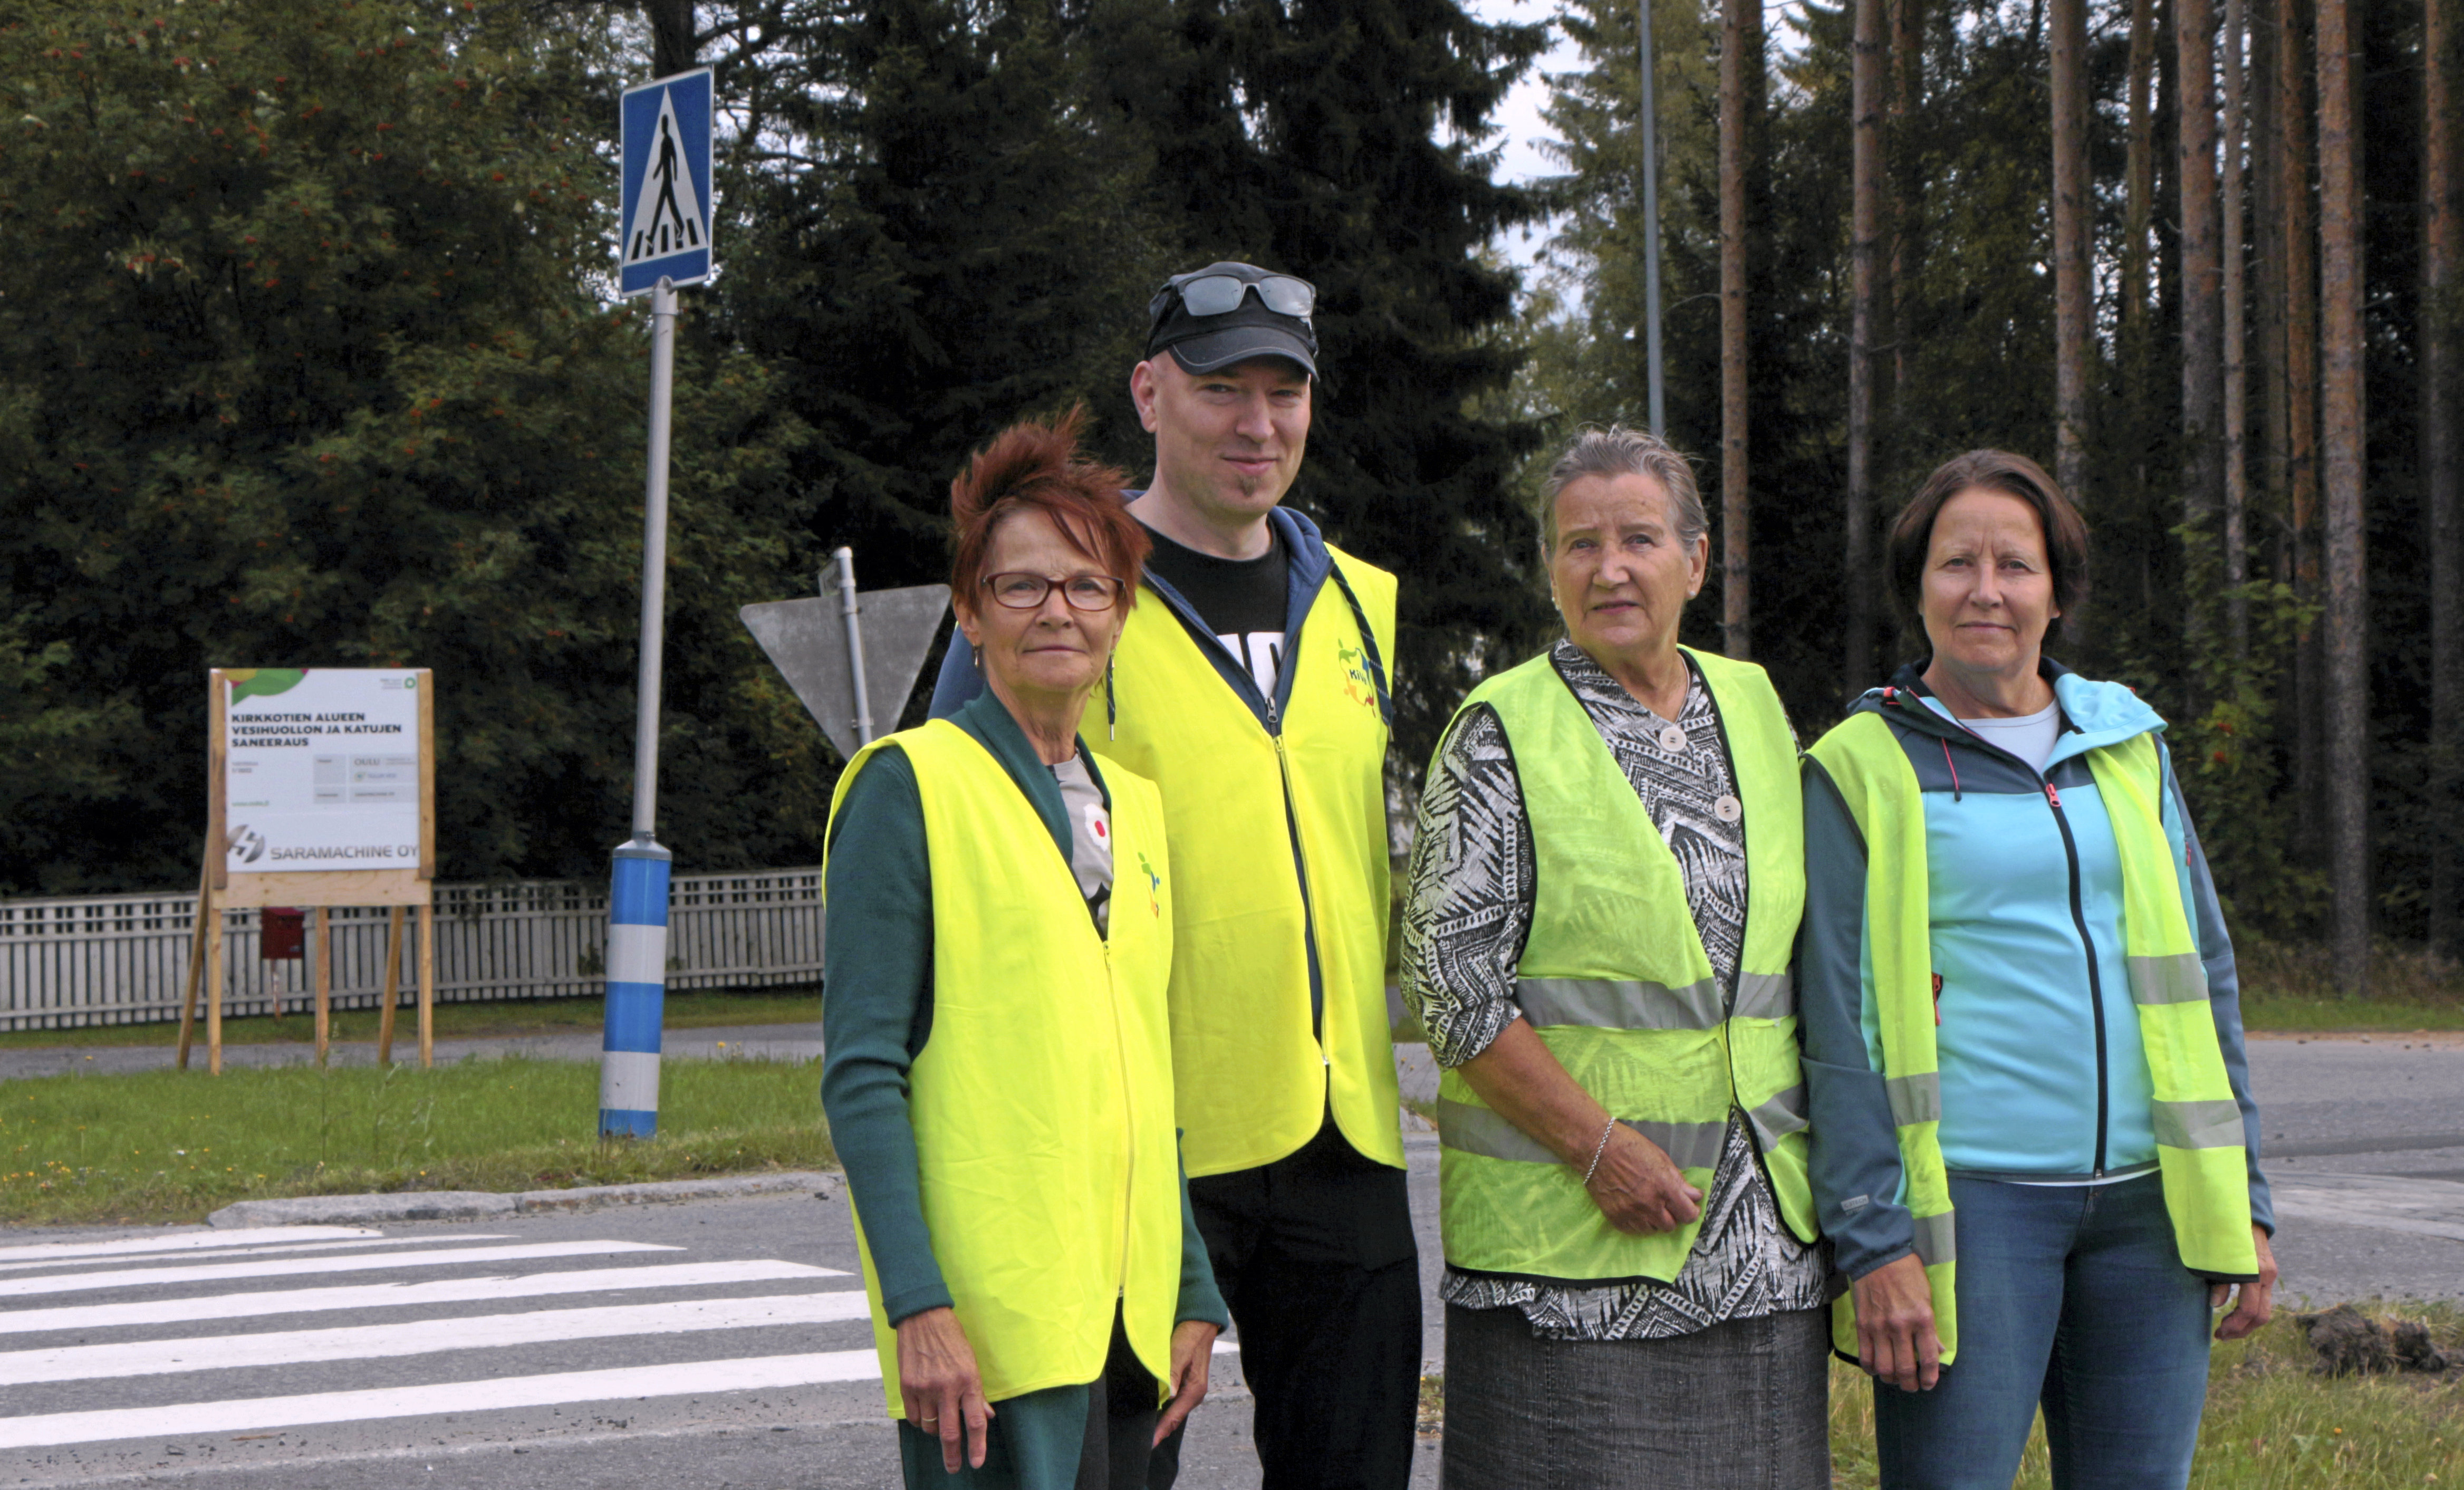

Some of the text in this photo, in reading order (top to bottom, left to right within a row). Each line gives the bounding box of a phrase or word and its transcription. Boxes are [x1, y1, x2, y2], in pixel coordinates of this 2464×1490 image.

[232, 713, 365, 722] KIRKKOTIEN ALUEEN
[232, 724, 401, 735] VESIHUOLLON JA KATUJEN
[232, 737, 309, 747] SANEERAUS
[270, 844, 418, 860] SARAMACHINE OY
